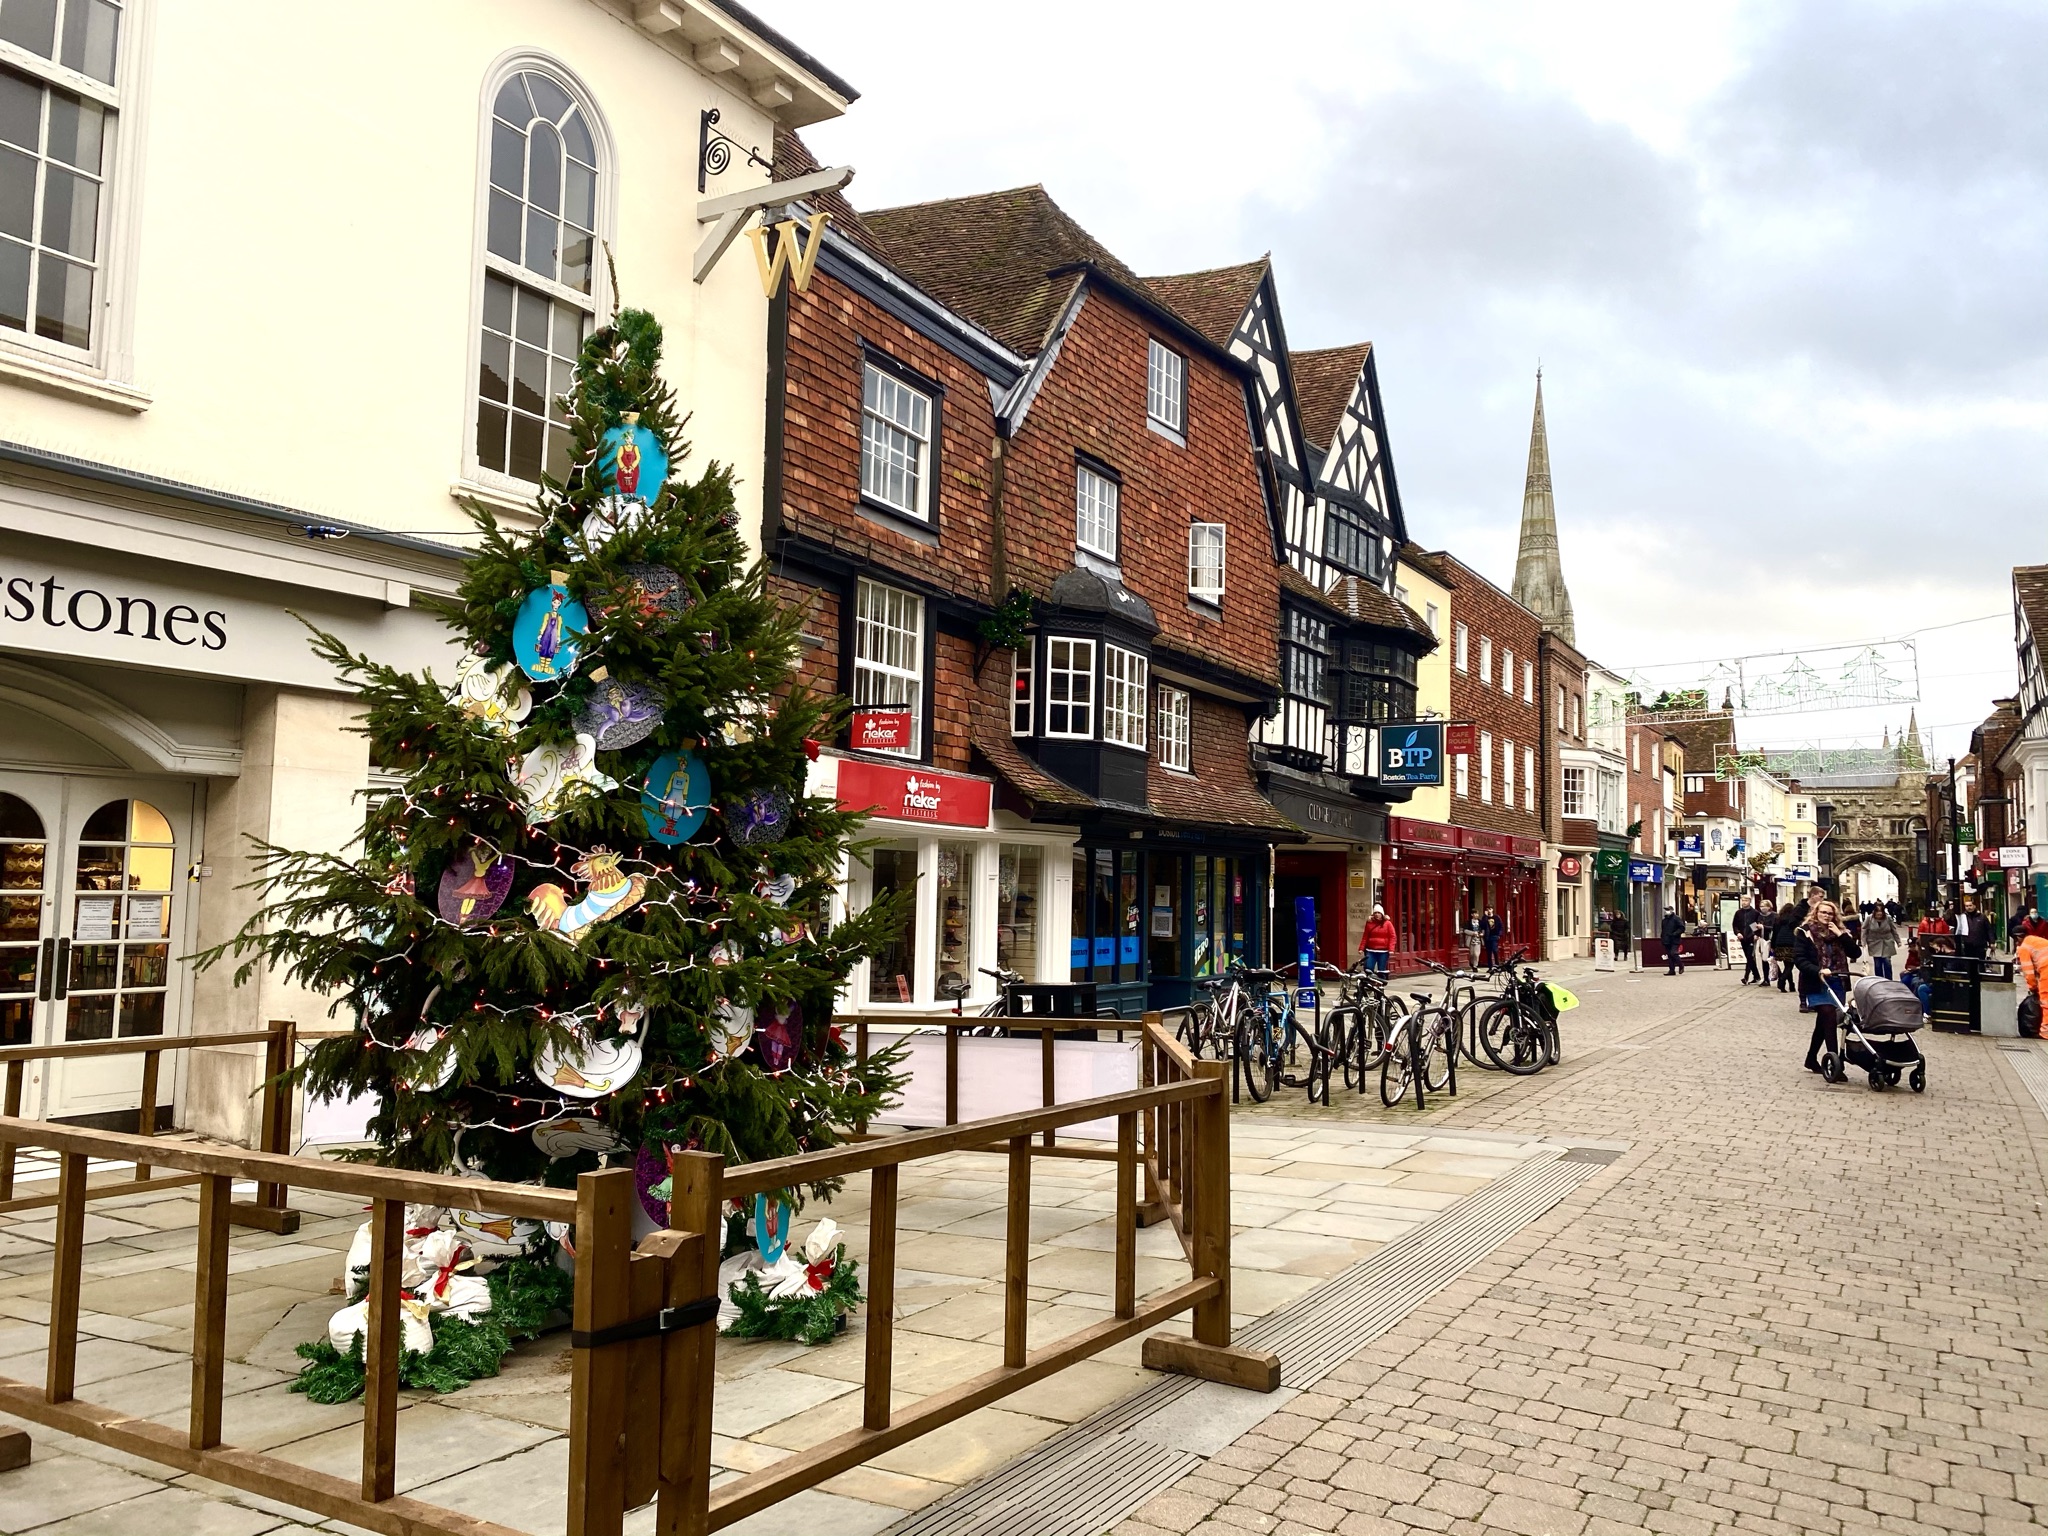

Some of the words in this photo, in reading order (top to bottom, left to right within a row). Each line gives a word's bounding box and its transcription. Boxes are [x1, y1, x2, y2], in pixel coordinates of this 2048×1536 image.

[744, 212, 834, 299] W
[0, 575, 228, 651] stones
[863, 726, 898, 739] rieker
[1388, 747, 1433, 768] BTP
[920, 778, 935, 789] fashion
[1382, 773, 1406, 781] Boston
[1419, 772, 1438, 782] Party
[903, 790, 941, 809] rieker
